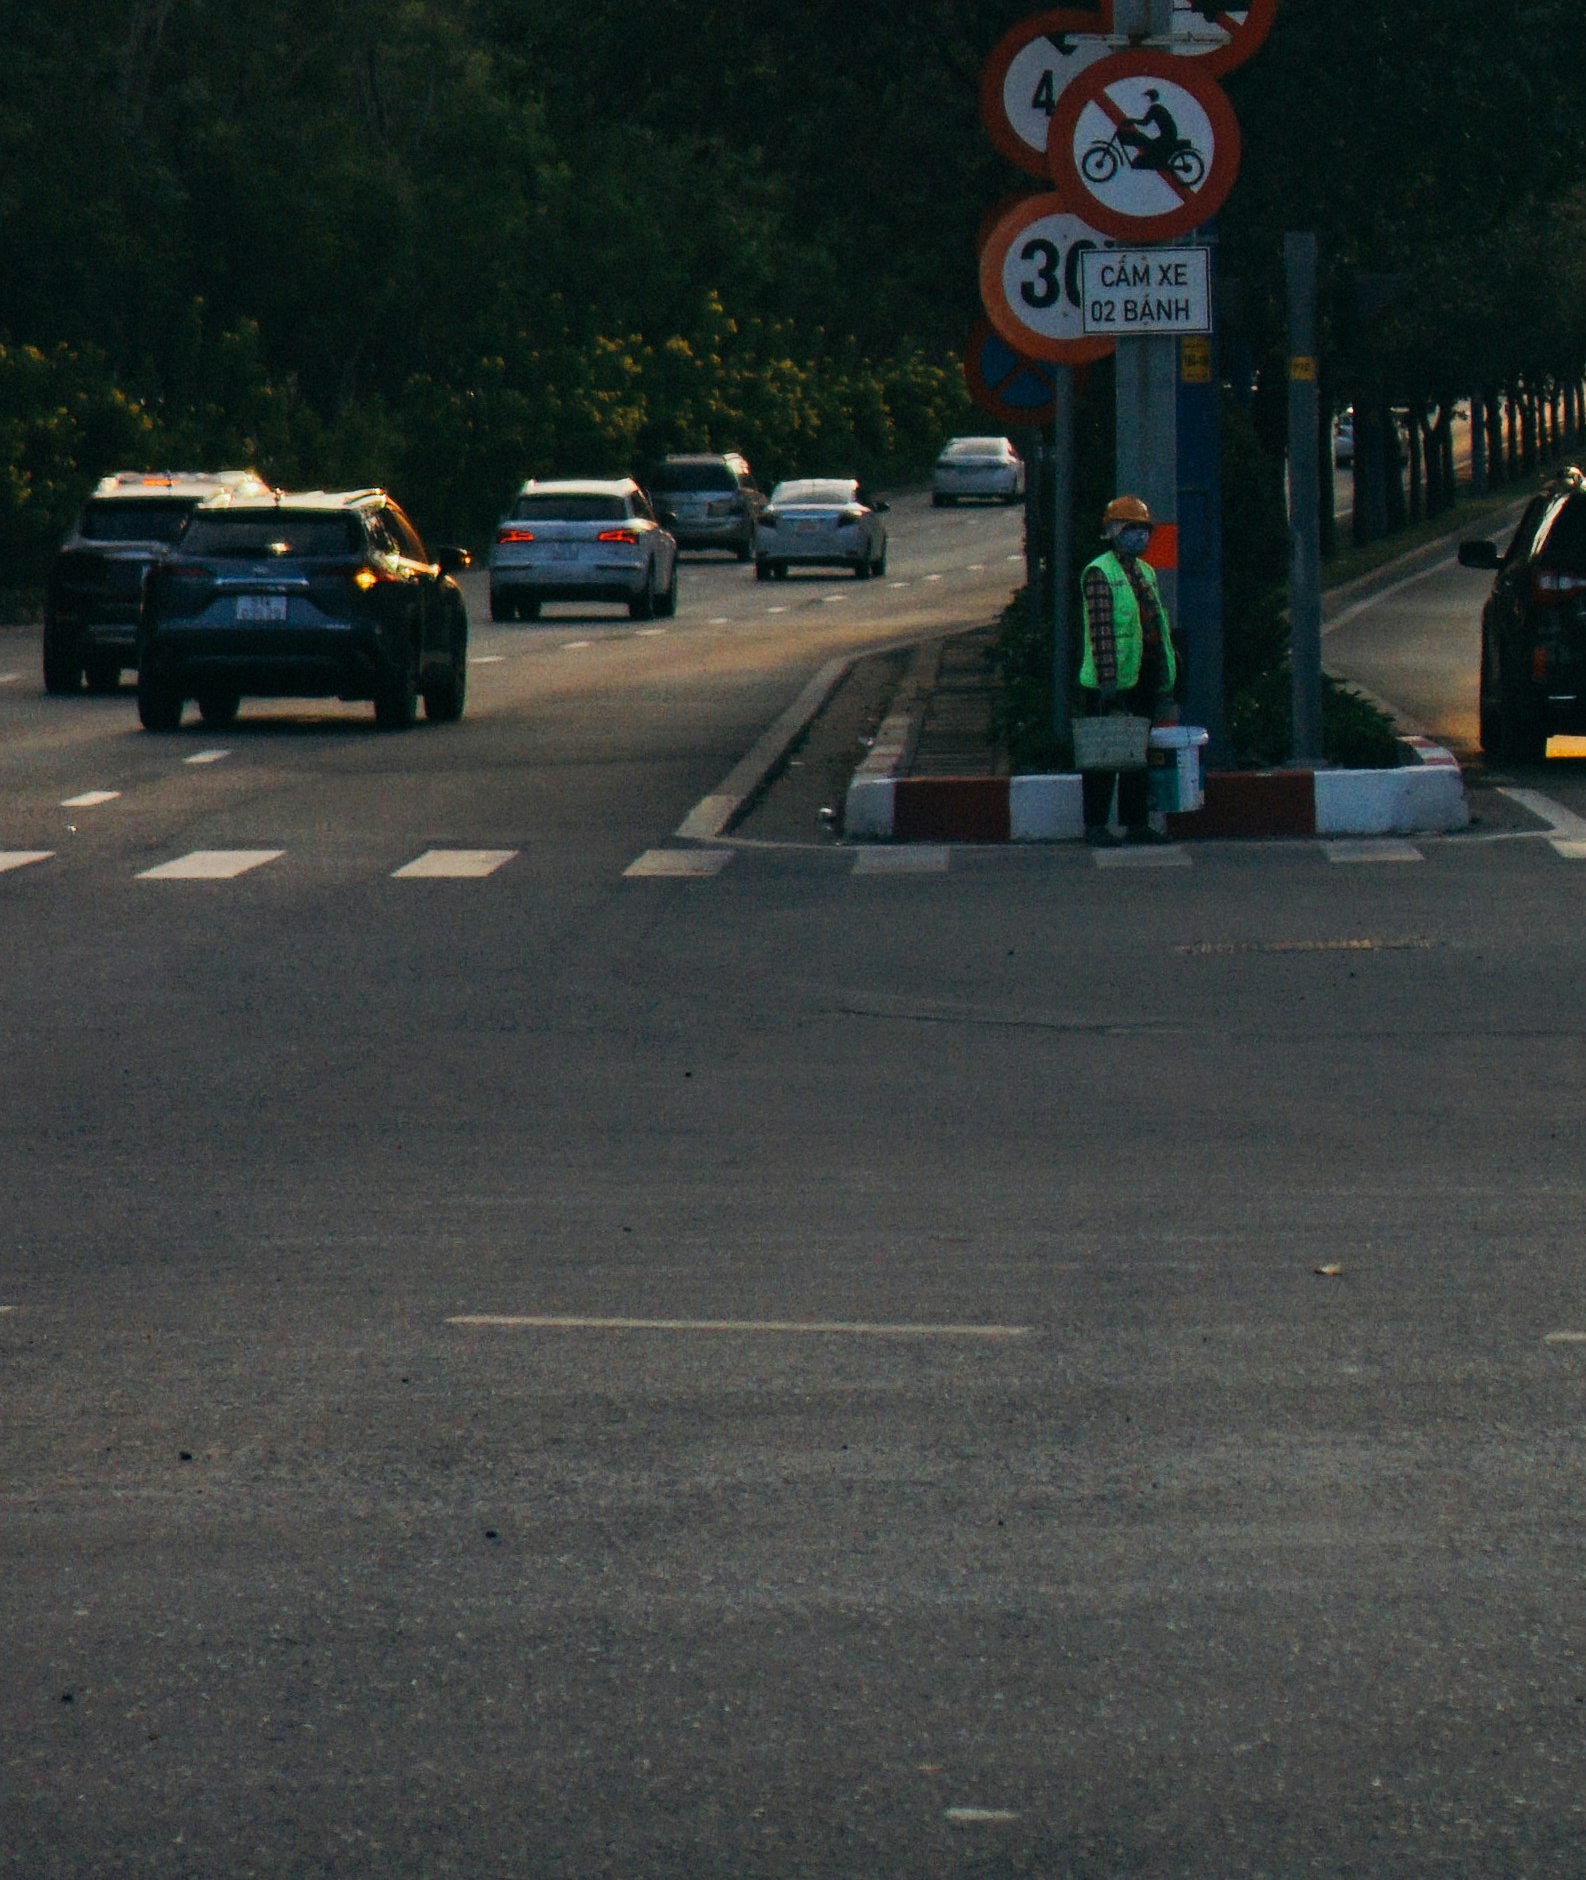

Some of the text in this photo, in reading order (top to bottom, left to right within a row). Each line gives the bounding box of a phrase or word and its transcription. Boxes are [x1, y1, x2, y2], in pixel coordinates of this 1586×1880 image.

[1100, 255, 1188, 287] CẤM XE
[1091, 294, 1190, 321] 02 BÁNH
